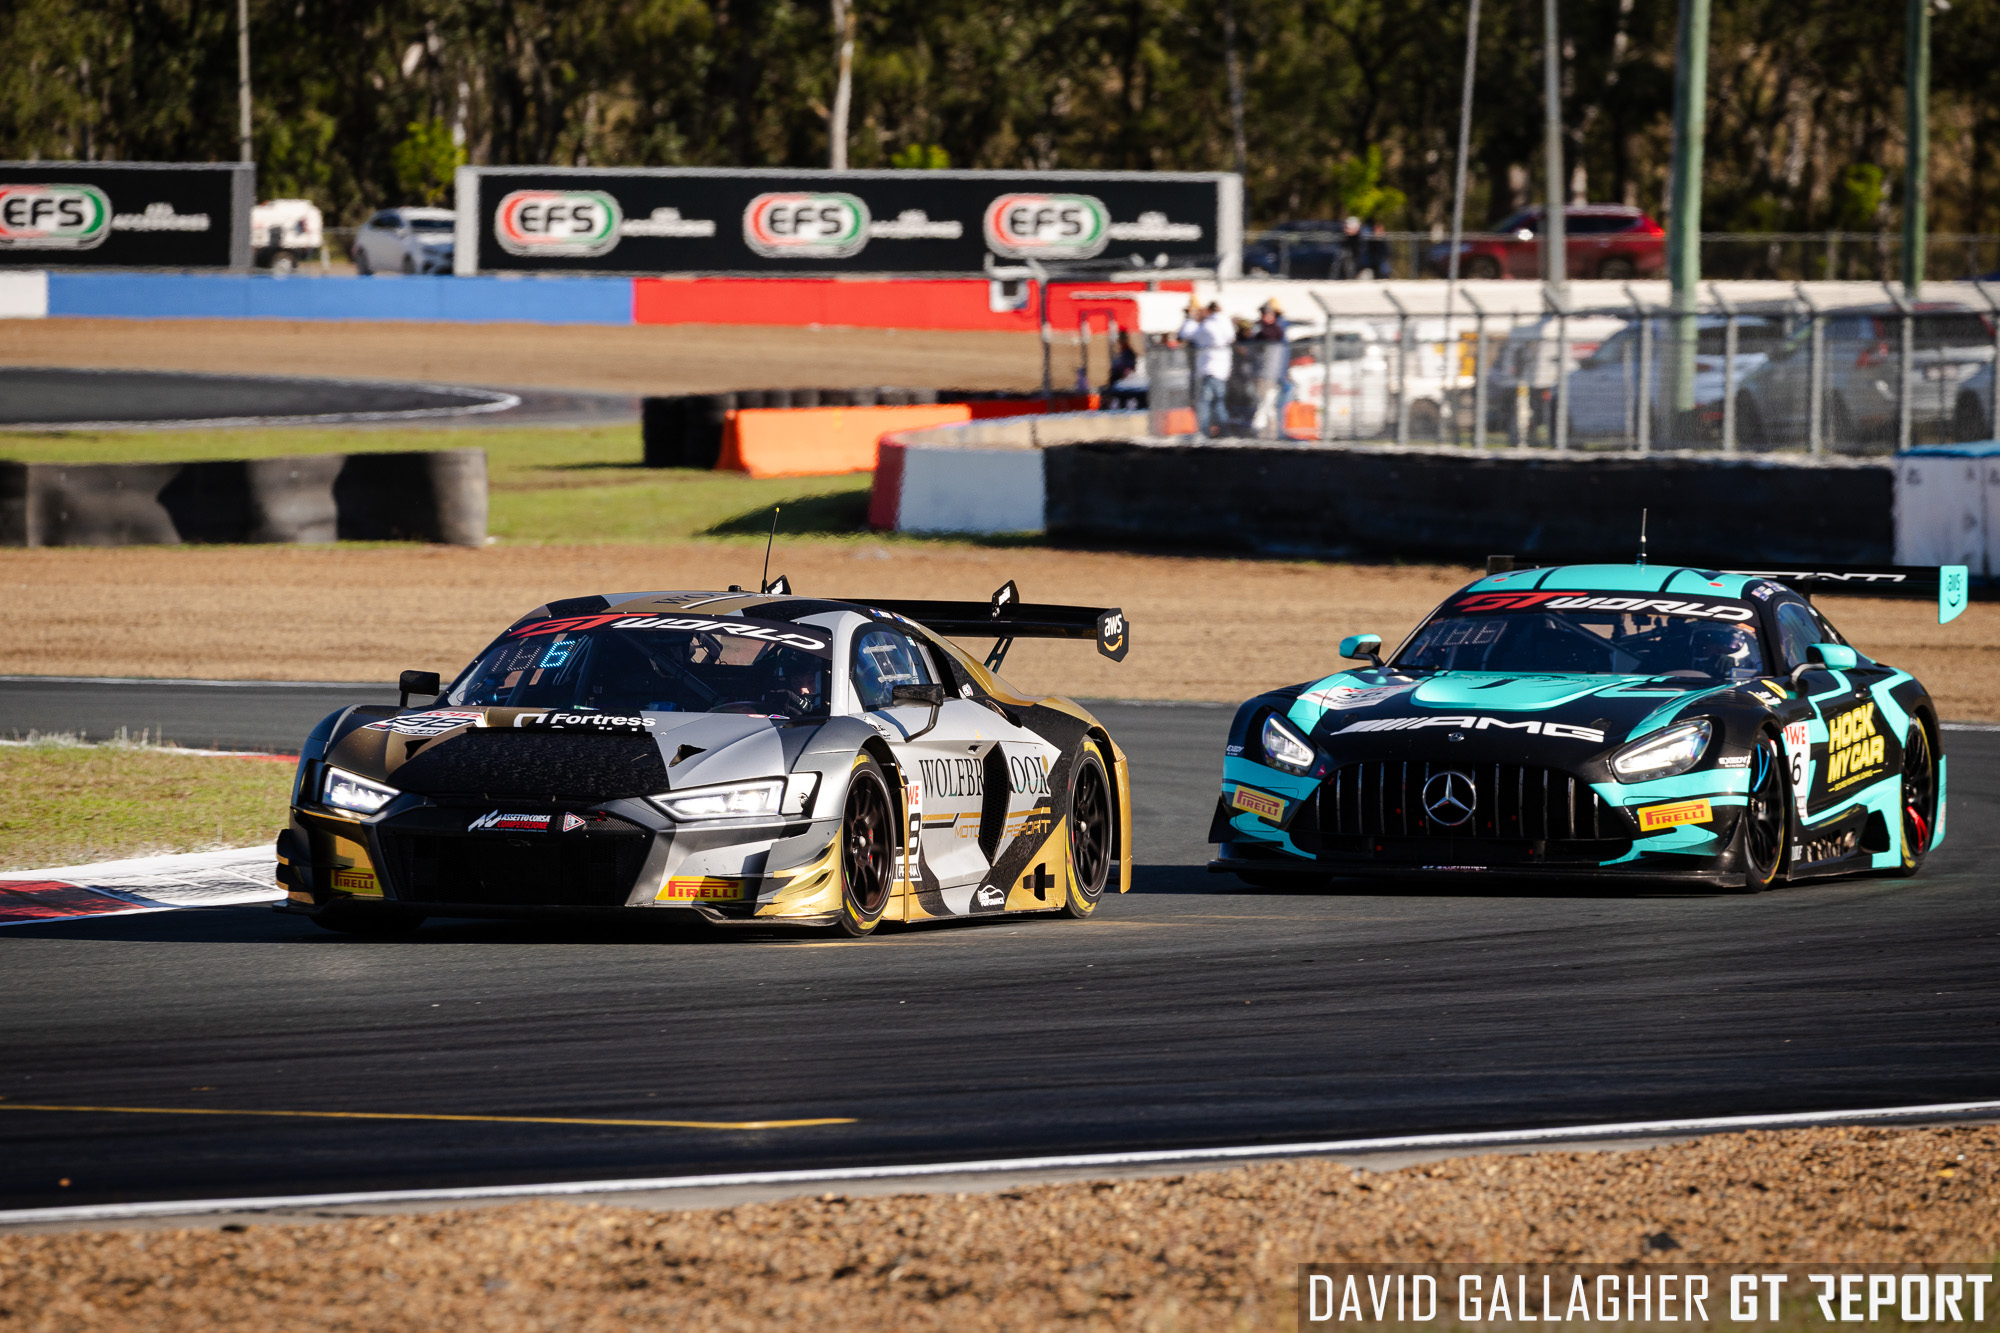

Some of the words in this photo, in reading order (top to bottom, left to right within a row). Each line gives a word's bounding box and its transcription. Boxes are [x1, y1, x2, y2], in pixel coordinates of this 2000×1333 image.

[3, 198, 84, 227] EFS
[520, 205, 594, 233] EFS
[769, 207, 842, 234] EFS
[1010, 208, 1081, 235] EFS
[1544, 596, 1754, 621] WORLD
[610, 617, 826, 650] WORLD
[1104, 613, 1123, 637] aws
[550, 713, 656, 727] Fortress
[1405, 715, 1605, 743] AMG
[1829, 702, 1876, 753] HOCK
[1237, 790, 1280, 816] PIRELLI
[1646, 804, 1705, 826] PIRELLI
[497, 820, 549, 829] COMPETIZIONE
[500, 813, 529, 821] ASSETTO
[334, 870, 375, 889] PIRELLI
[668, 881, 739, 898] PIRELLI
